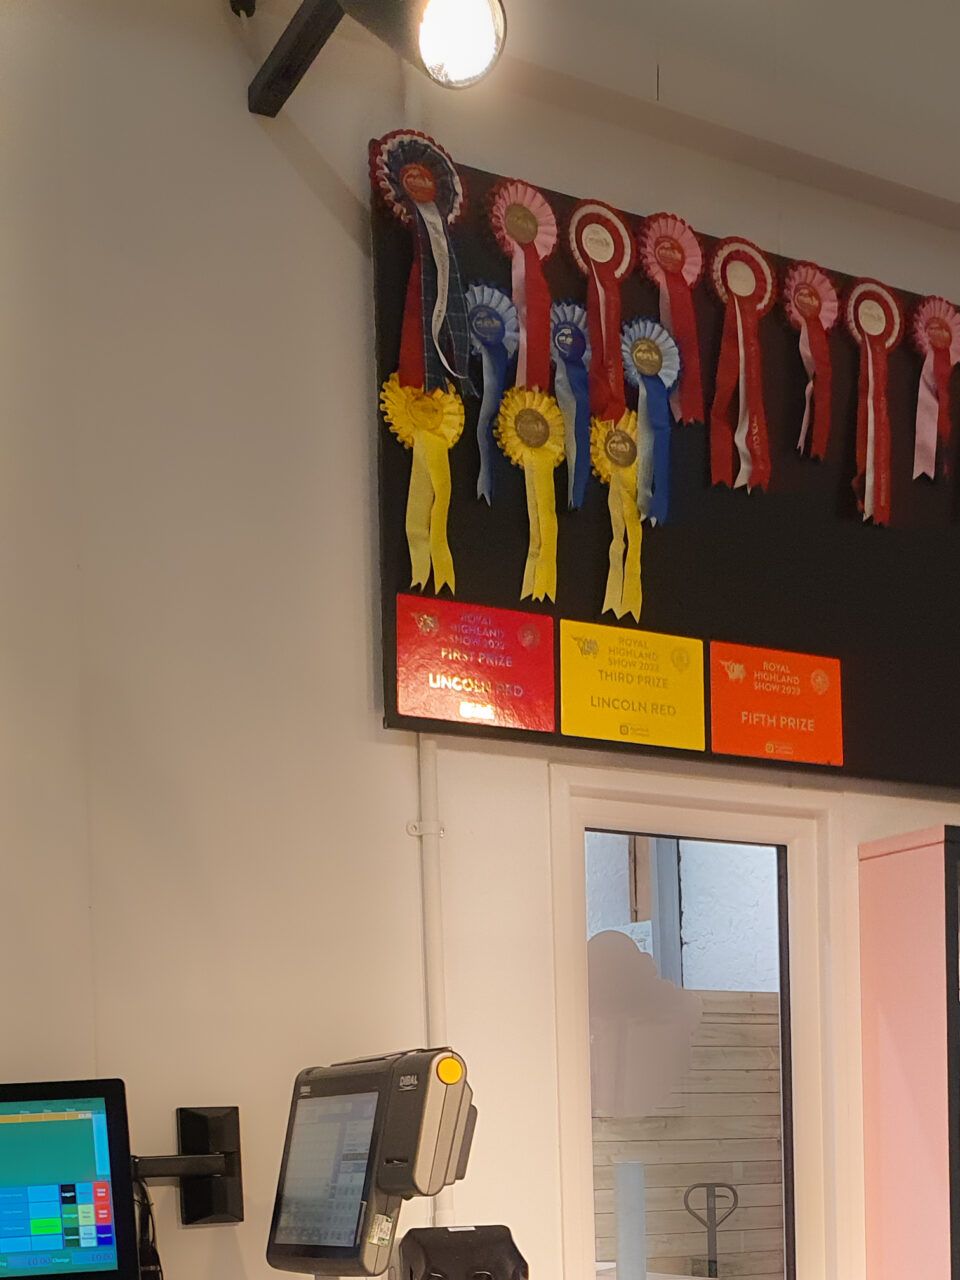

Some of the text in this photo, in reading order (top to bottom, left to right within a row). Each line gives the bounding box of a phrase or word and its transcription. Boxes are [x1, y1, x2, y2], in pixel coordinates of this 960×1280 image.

[619, 637, 649, 650] ROYAL
[441, 648, 513, 668] FIRST PRIZE
[608, 647, 657, 662] HIGHLAND
[608, 657, 636, 669] SHOW
[763, 661, 790, 674] ROYAL
[428, 672, 492, 694] LINCOLN
[598, 669, 669, 689] THIRD PRIZE
[753, 671, 800, 685] HIGHLAND
[753, 682, 780, 693] SHOW
[590, 695, 677, 717] LINCOLN RED
[741, 711, 815, 732] FIFTH PRIZE
